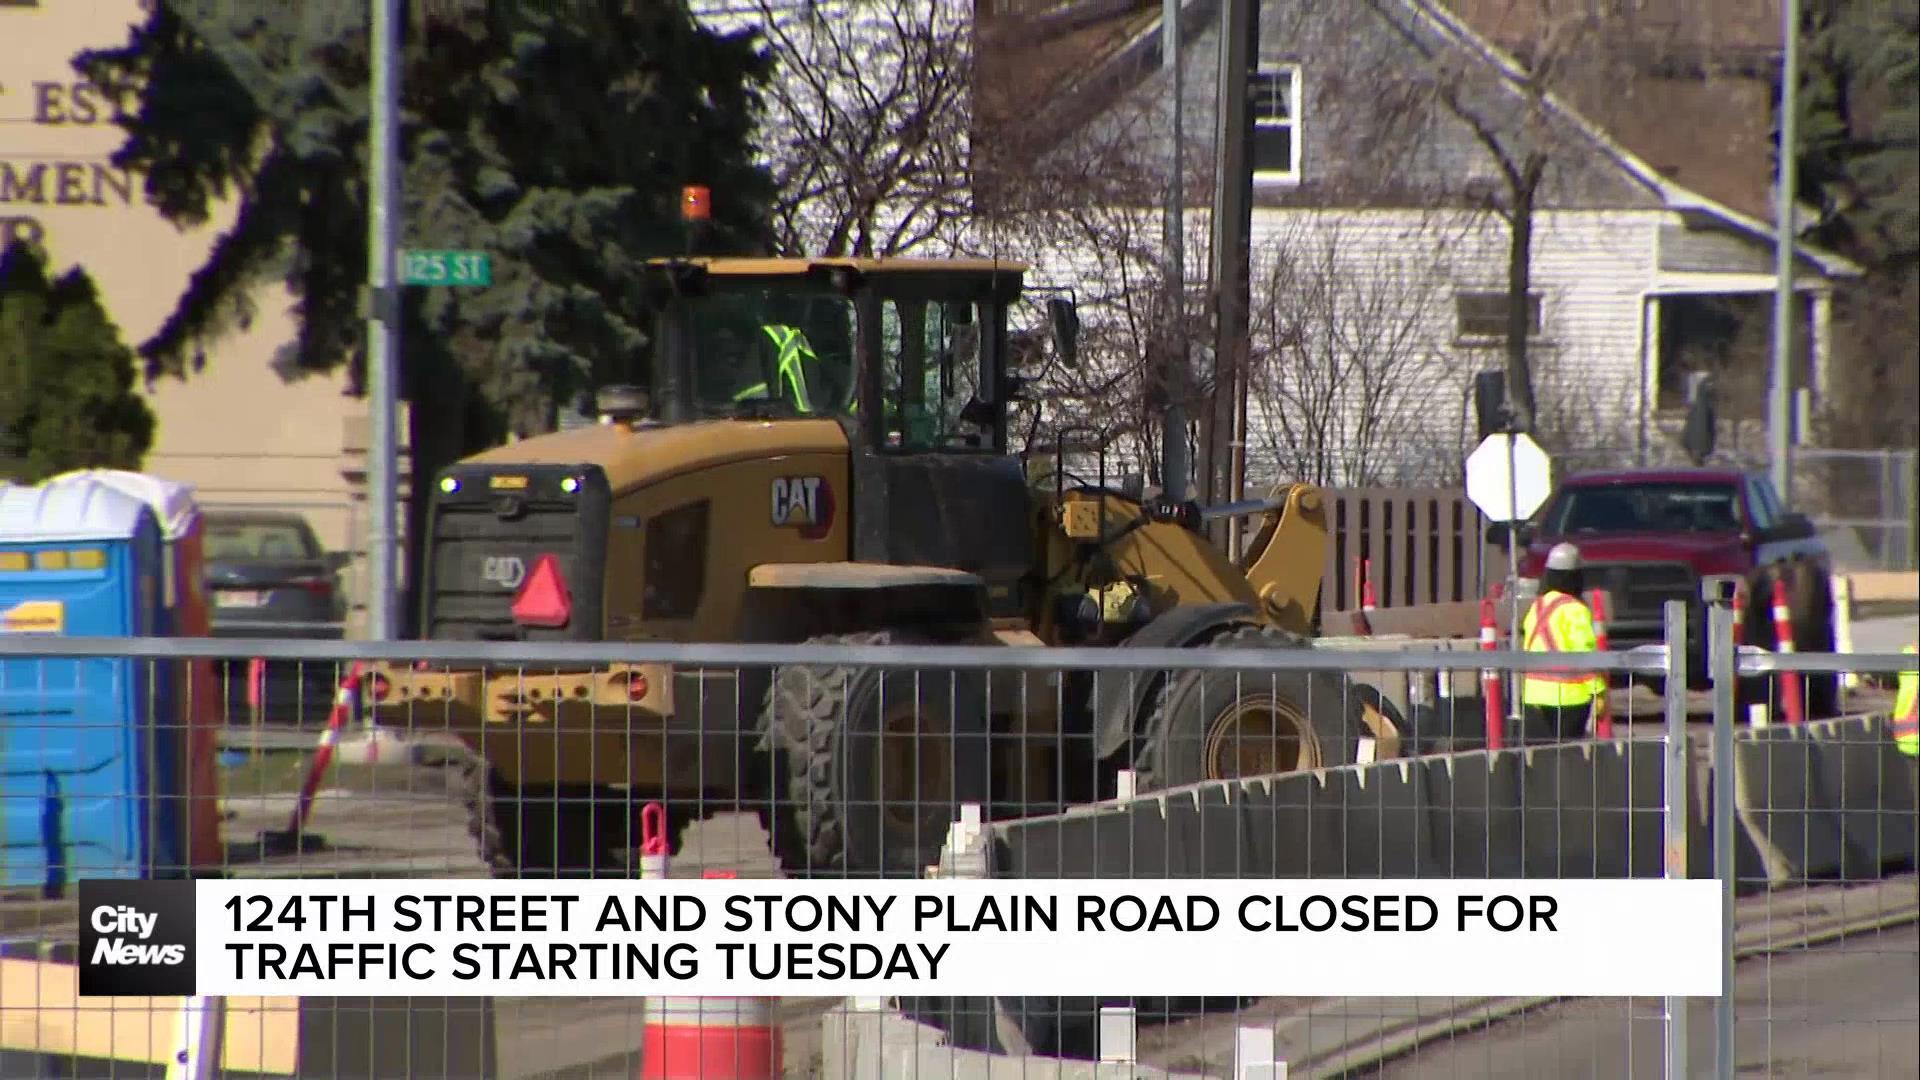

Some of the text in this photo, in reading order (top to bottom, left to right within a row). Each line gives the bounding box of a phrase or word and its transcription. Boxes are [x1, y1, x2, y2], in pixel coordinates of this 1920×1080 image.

[404, 254, 482, 280] 125 ST
[770, 476, 822, 526] CAT
